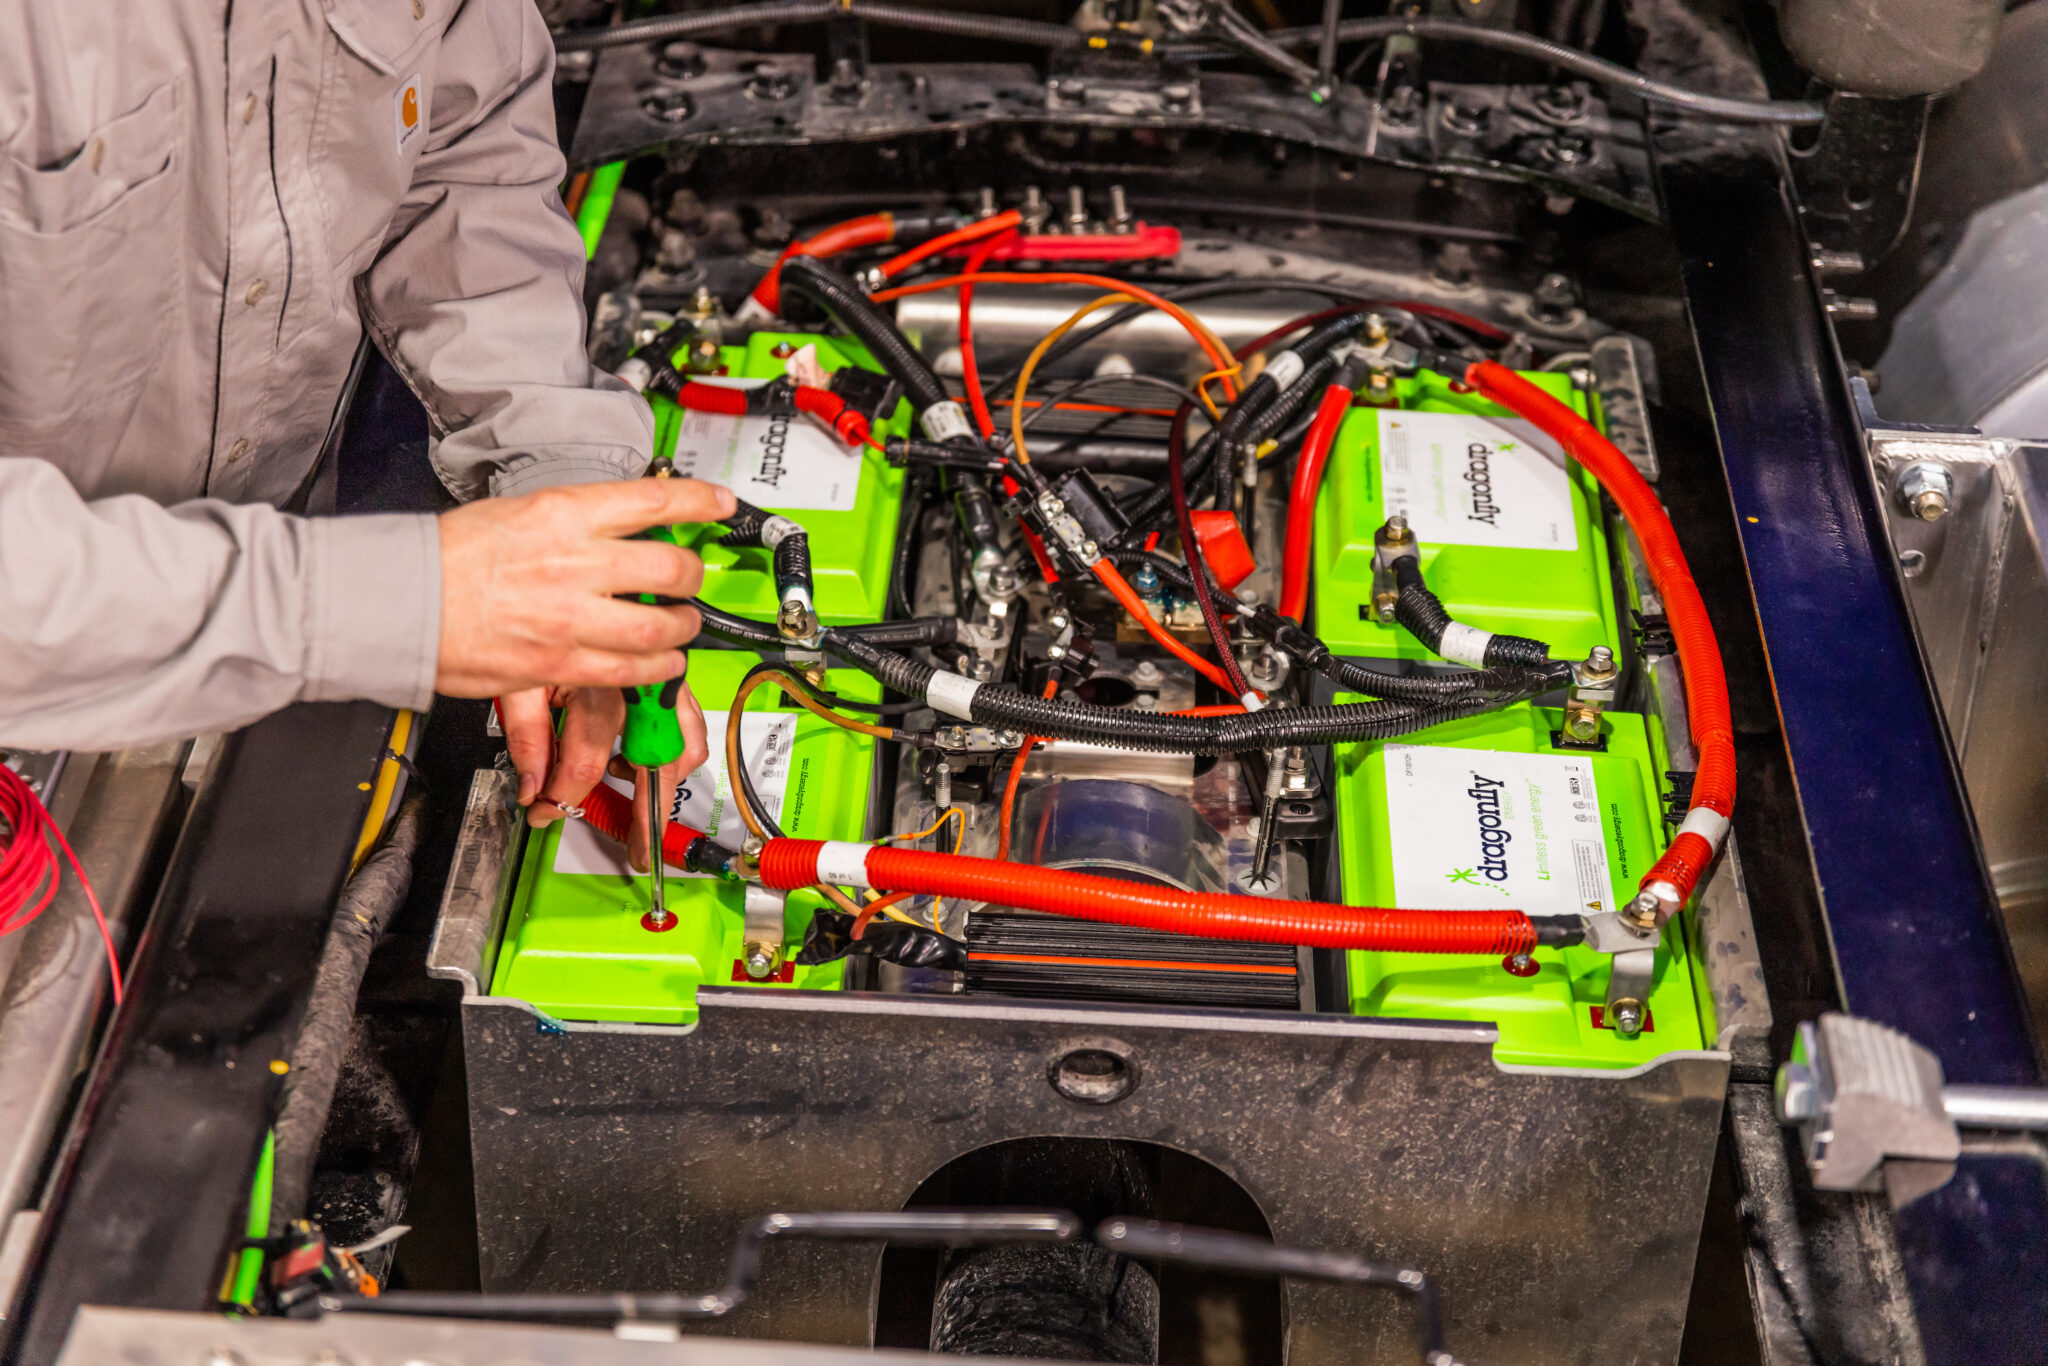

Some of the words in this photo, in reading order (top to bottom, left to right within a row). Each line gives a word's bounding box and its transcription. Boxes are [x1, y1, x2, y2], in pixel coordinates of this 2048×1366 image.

[1463, 442, 1502, 526] dragonfly
[703, 798, 724, 837] Limitless
[715, 771, 729, 797] green
[791, 758, 810, 832] www.dragonflyenergy.com
[1468, 773, 1512, 881] dragonfly
[1503, 791, 1515, 820] ENERGY
[1526, 783, 1542, 813] energy
[1531, 814, 1548, 841] green
[1534, 841, 1550, 881] Limitless
[1610, 803, 1629, 879] www.dragonflyenergy.com
